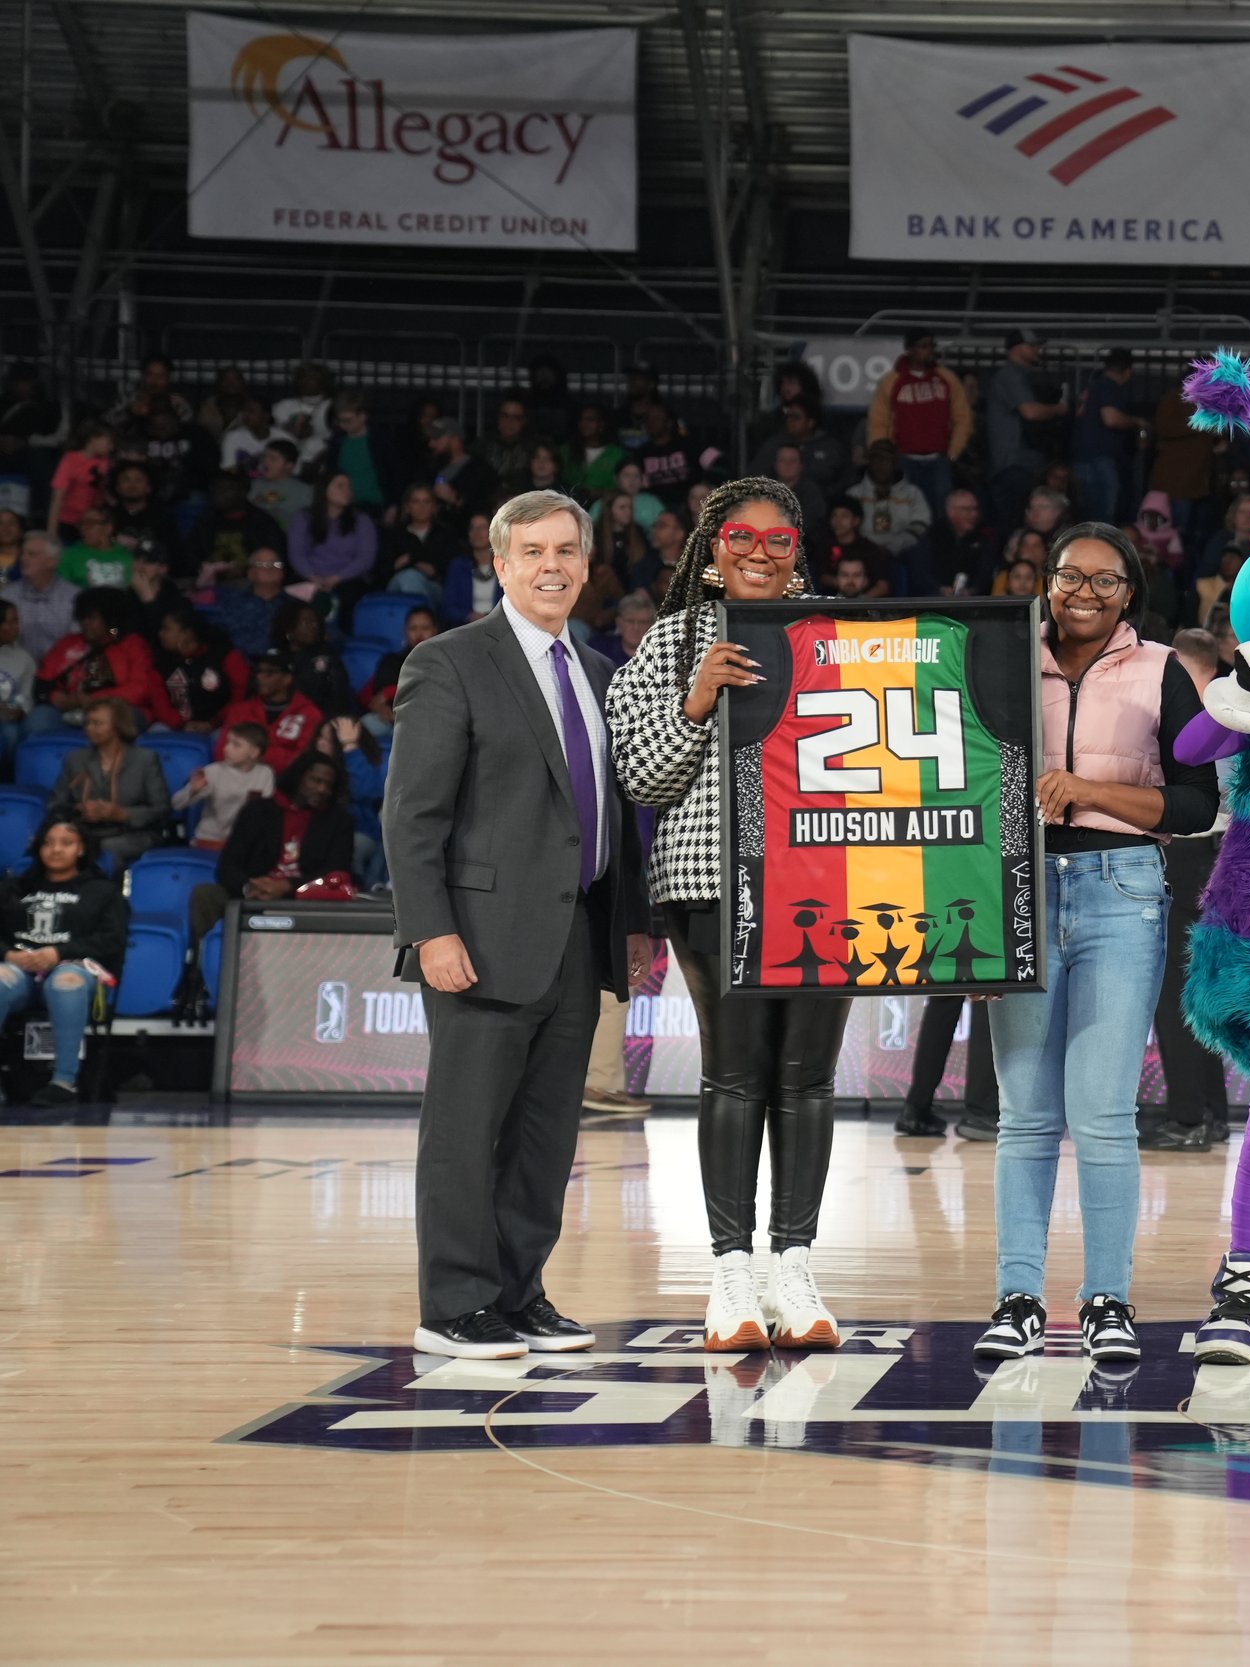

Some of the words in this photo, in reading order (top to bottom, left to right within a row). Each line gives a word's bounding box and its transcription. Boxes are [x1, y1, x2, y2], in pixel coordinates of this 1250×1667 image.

[275, 75, 593, 185] Allegacy
[273, 208, 388, 233] FEDERAL
[398, 212, 491, 235] CREDIT
[501, 215, 589, 237] UNION
[907, 214, 1001, 240] BANK
[1013, 216, 1056, 240] OF
[1065, 217, 1224, 242] AMERICA
[829, 640, 861, 665] NBA
[861, 638, 886, 665] G
[886, 638, 941, 665] LEAGUE
[795, 687, 968, 794] 24
[796, 811, 896, 843] HUDSON
[906, 809, 975, 840] AUTO
